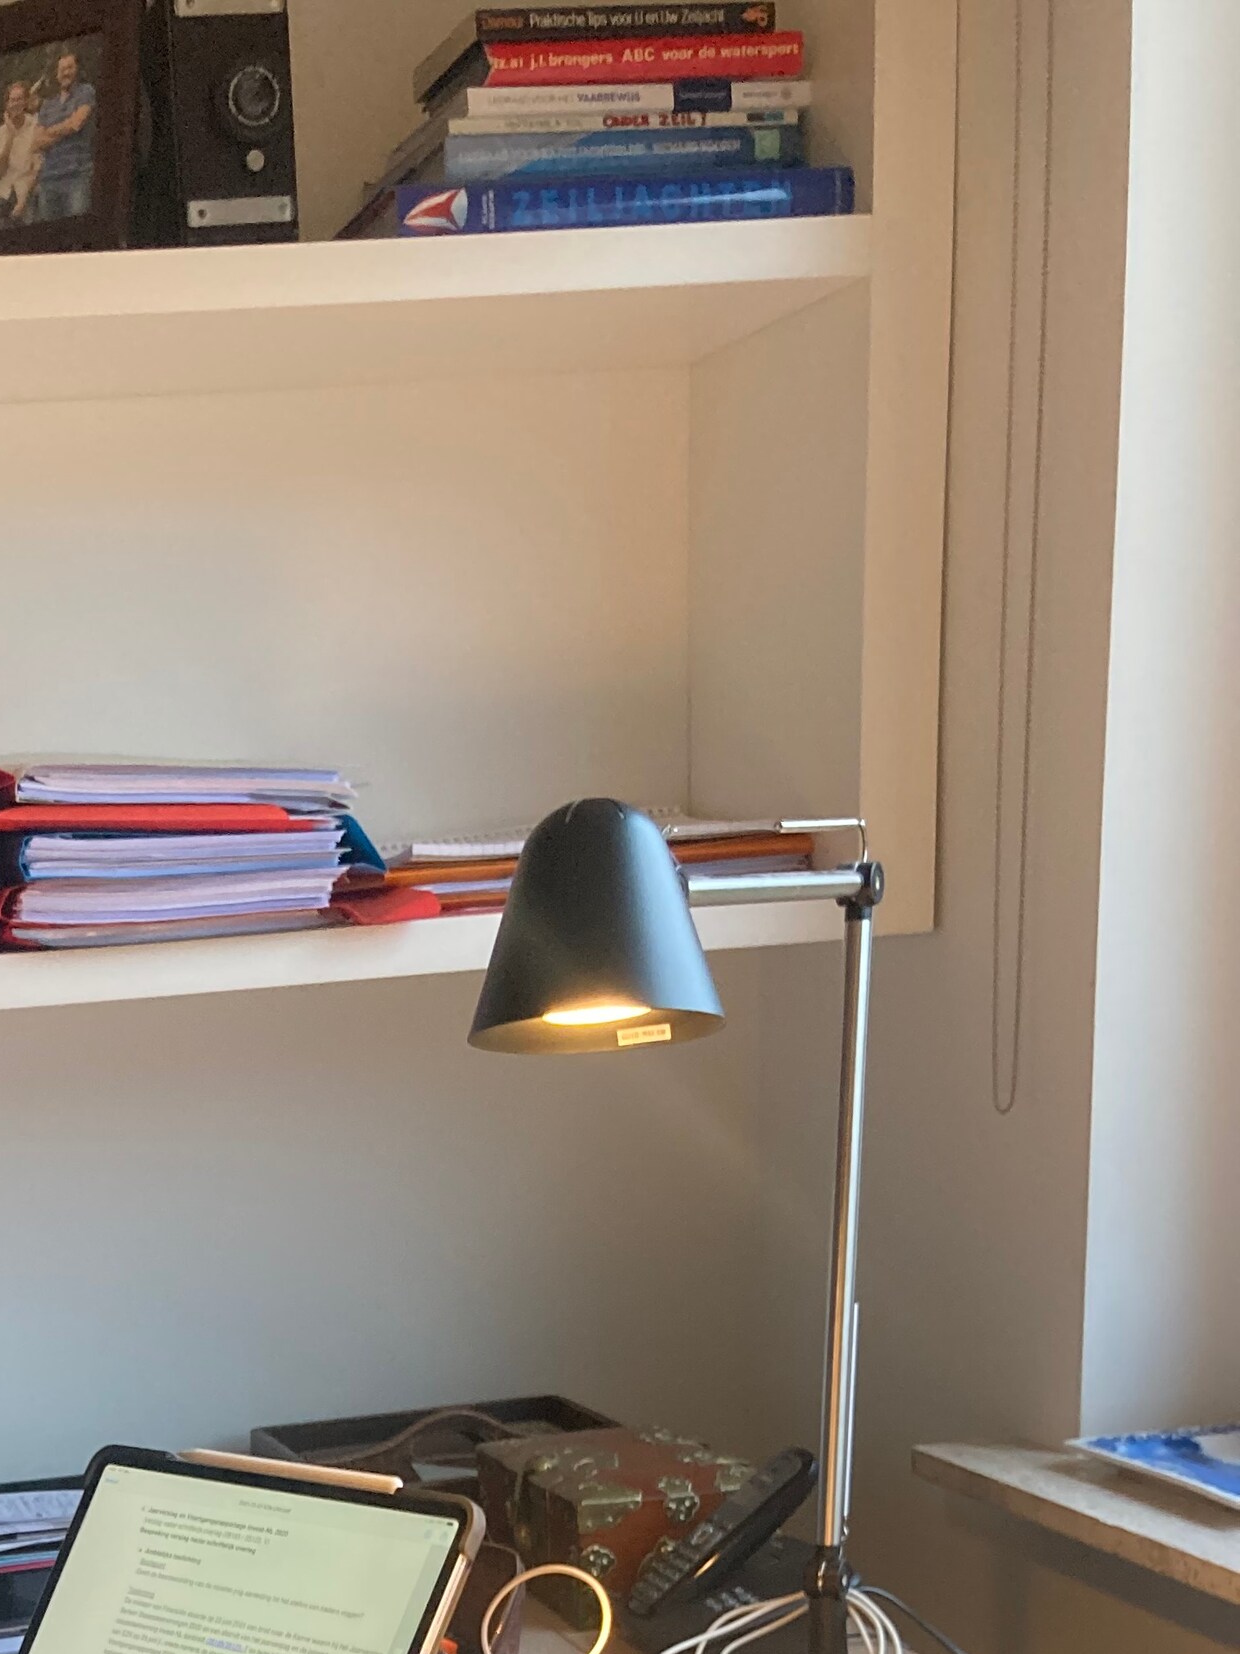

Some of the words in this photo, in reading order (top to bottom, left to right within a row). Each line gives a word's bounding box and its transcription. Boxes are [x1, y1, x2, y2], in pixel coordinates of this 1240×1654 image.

[622, 47, 655, 62] ABC
[662, 49, 694, 64] voor
[698, 45, 716, 59] de
[720, 43, 800, 59] watersport
